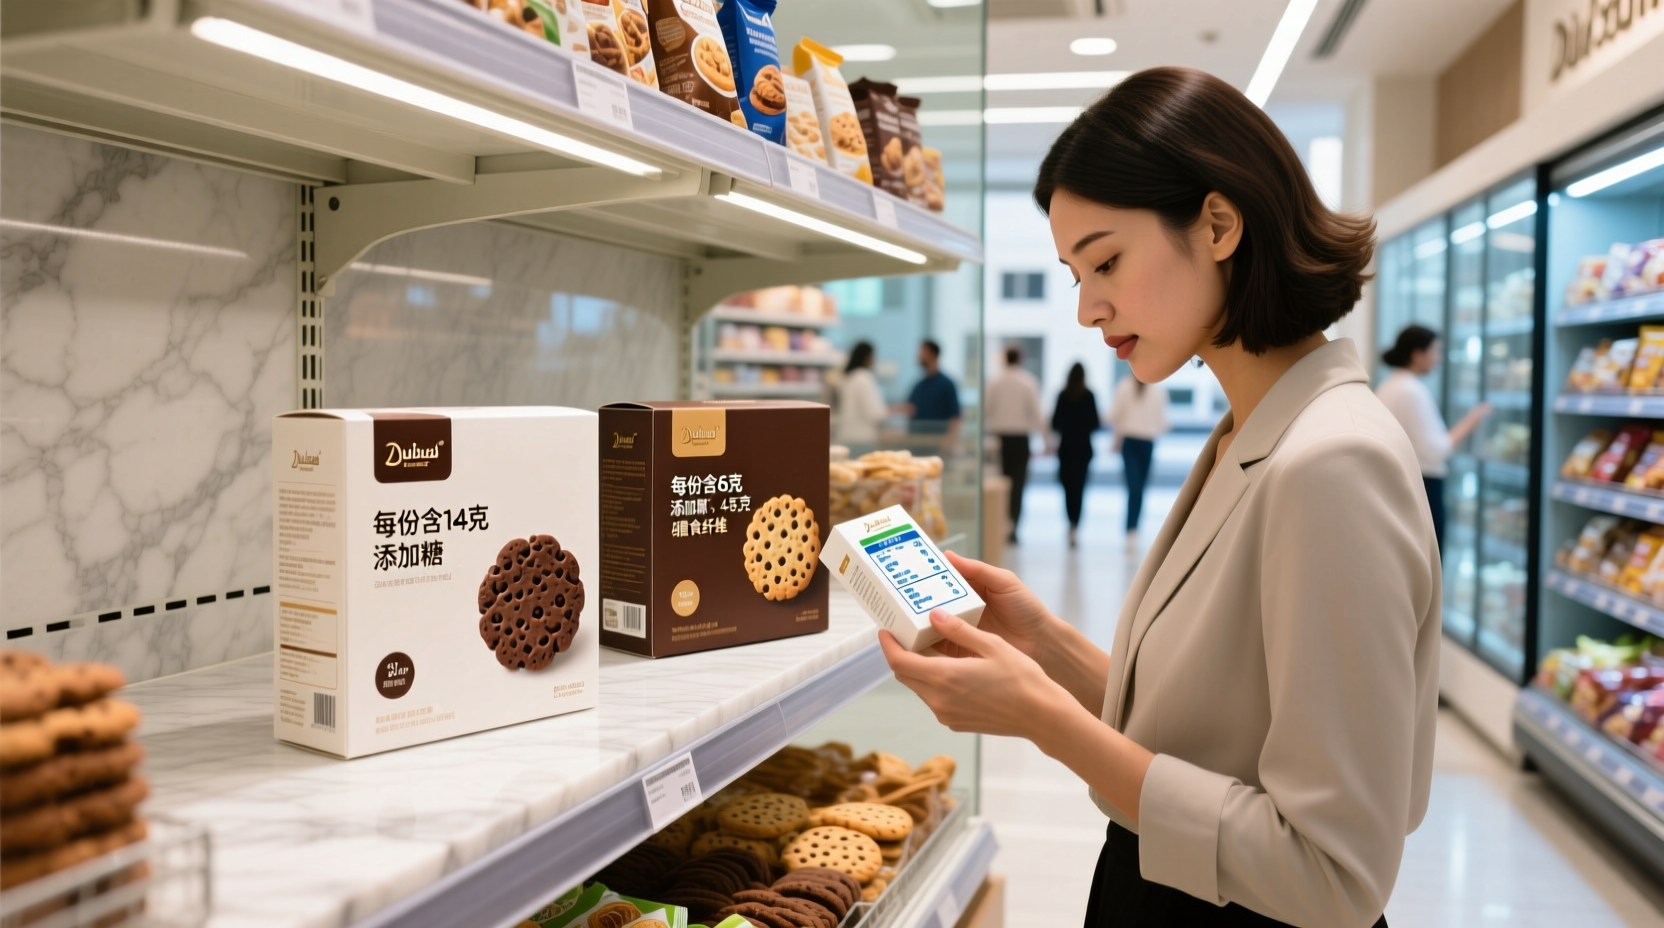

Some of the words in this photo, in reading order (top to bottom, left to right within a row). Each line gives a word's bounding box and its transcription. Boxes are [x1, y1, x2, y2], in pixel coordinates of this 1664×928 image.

[671, 473, 743, 497] 每份含6克
[373, 503, 489, 538] 每份含14克
[373, 539, 444, 571] 添加糖
